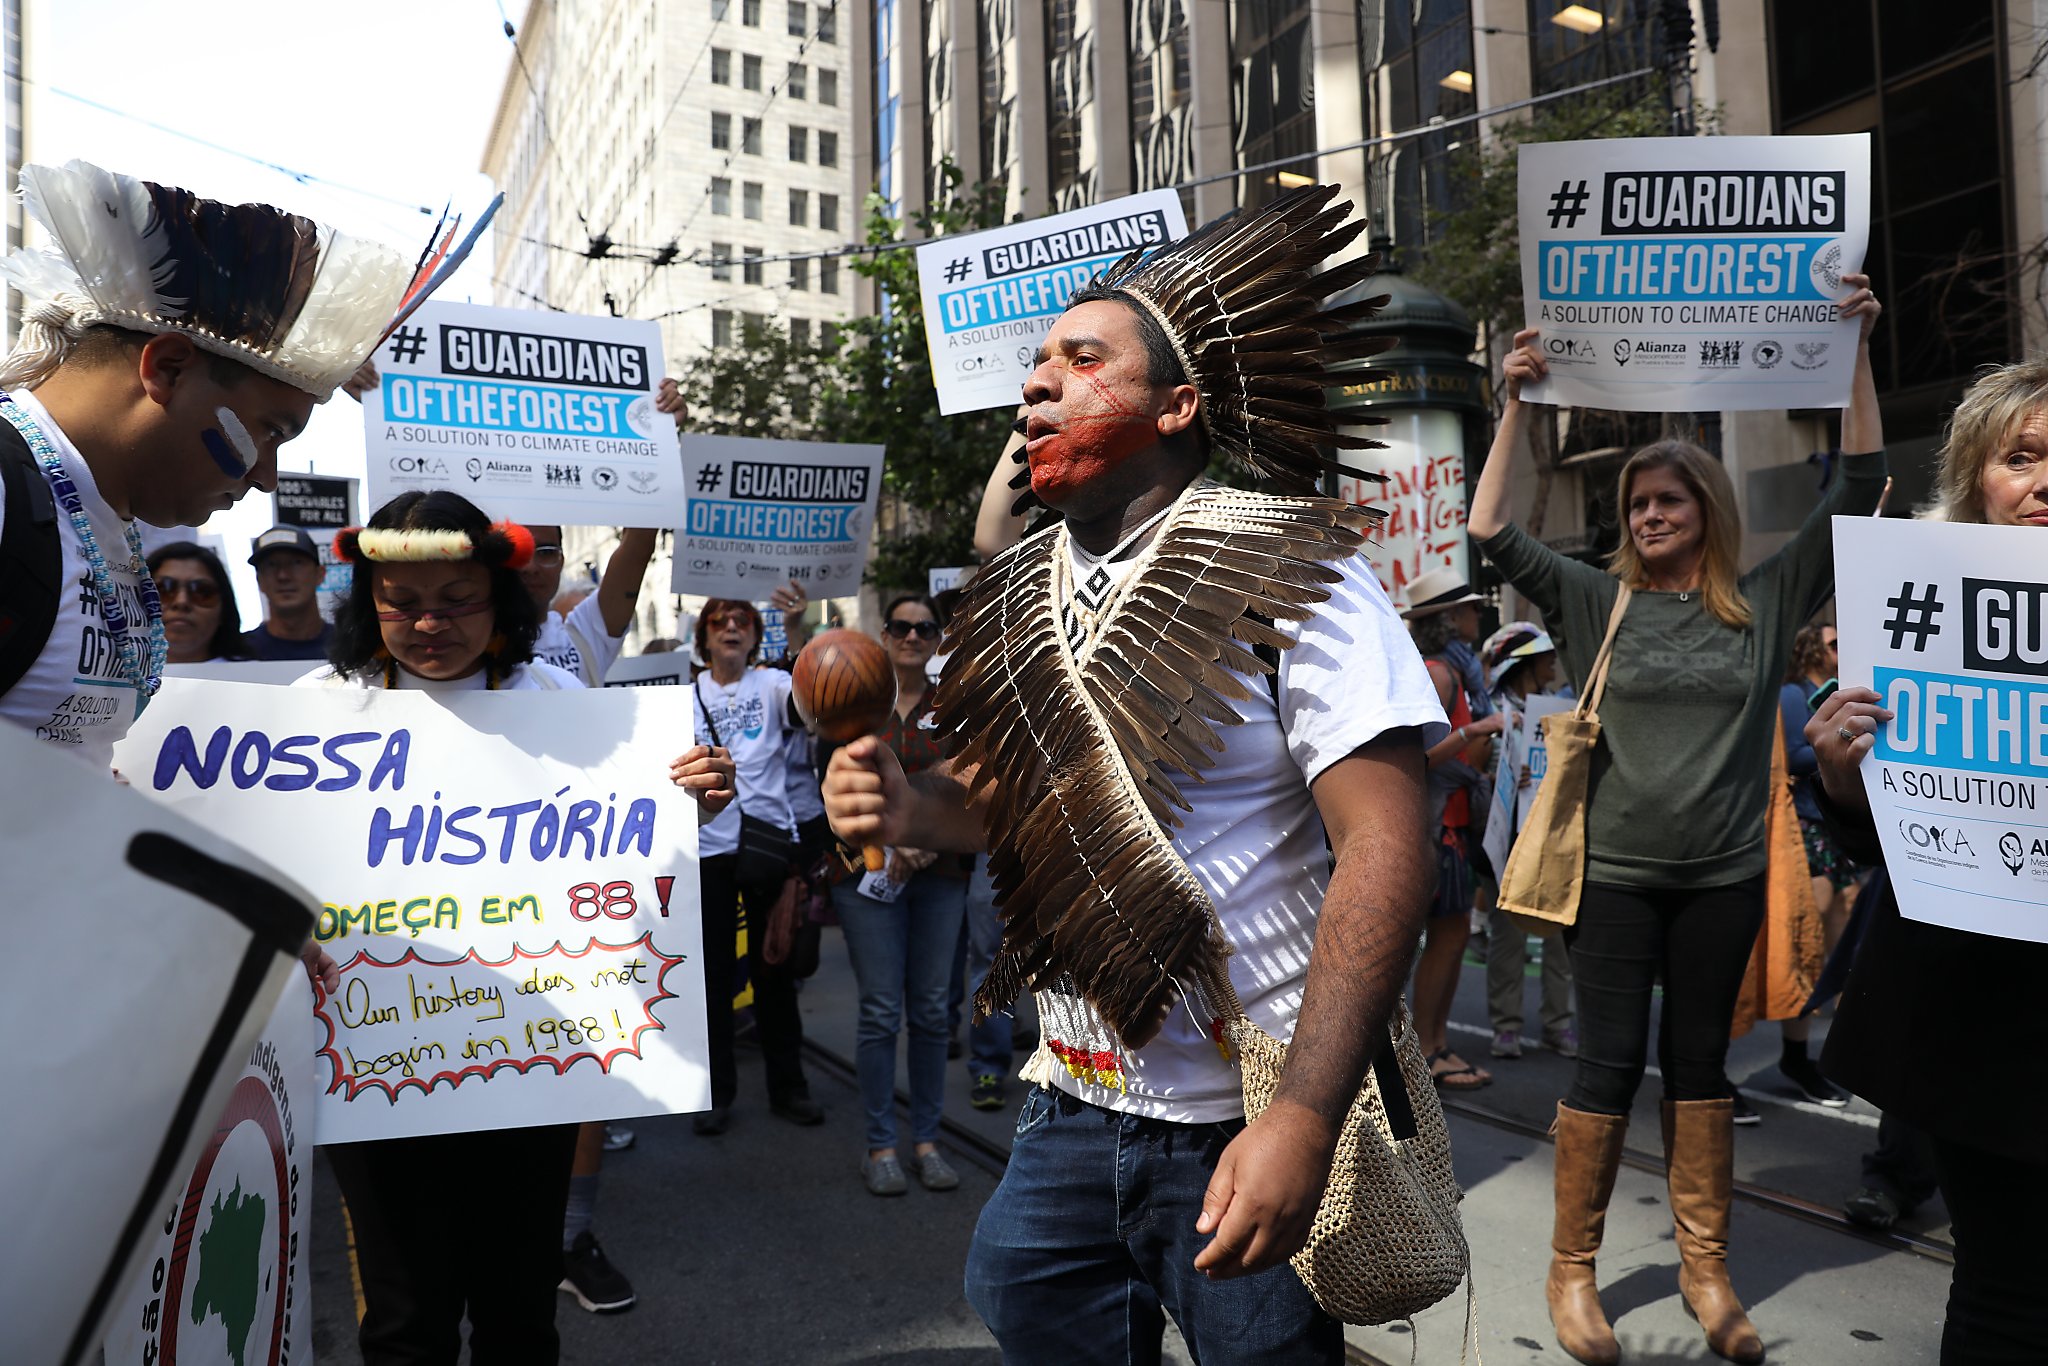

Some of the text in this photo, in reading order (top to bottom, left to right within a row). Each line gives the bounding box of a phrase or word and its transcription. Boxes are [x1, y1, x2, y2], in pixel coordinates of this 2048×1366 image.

[1611, 176, 1836, 228] GUARDIANS
[988, 214, 1163, 275] GUARDIANS
[1546, 243, 1806, 295] OFTHEFOREST
[1541, 304, 1838, 324] A SOLUTION TO CLIMATE CHANGE
[949, 335, 958, 348] A
[961, 321, 1034, 346] SOLUTION
[1635, 341, 1686, 353] Alianza
[447, 329, 643, 386] GUARDIANS
[391, 379, 622, 434] OFTHEFOREST
[386, 427, 659, 457] A SOLUTION TO CLIMATE CHANGE
[486, 461, 532, 473] Alianza
[735, 464, 864, 499] GUARDIANS
[323, 511, 344, 522] ALL
[692, 502, 844, 539] OFTHEFOREST
[687, 539, 858, 556] A SOLUTION TO CLIMATE CHANGE
[46, 713, 71, 727] TO
[56, 695, 120, 715] A SOLUTION
[153, 726, 411, 791] NOSSA
[1883, 767, 2035, 810] A SOLUTION
[314, 896, 461, 940] OMEÇA
[481, 894, 543, 925] EM
[335, 977, 401, 1029] Our
[408, 973, 505, 1022] history
[591, 958, 648, 987] not
[345, 1034, 446, 1078] begin
[461, 1032, 510, 1060] in
